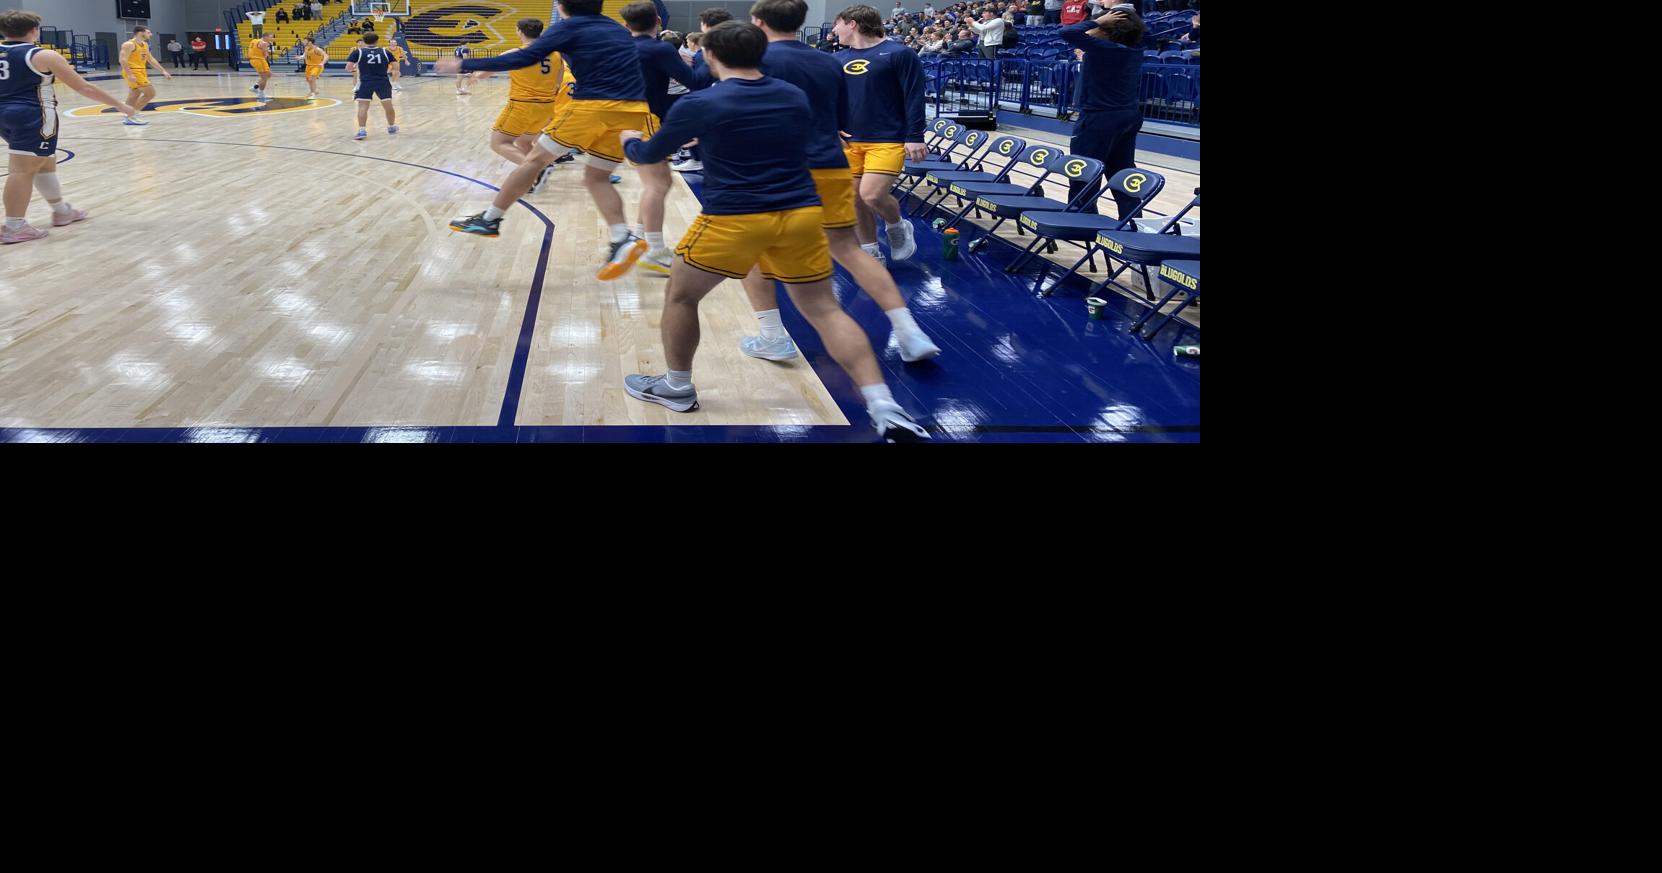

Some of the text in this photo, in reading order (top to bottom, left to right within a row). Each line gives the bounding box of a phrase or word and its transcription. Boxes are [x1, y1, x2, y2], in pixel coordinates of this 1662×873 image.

[367, 53, 381, 64] 21
[541, 58, 551, 75] 5
[1160, 264, 1197, 290] BLUGOLDS
